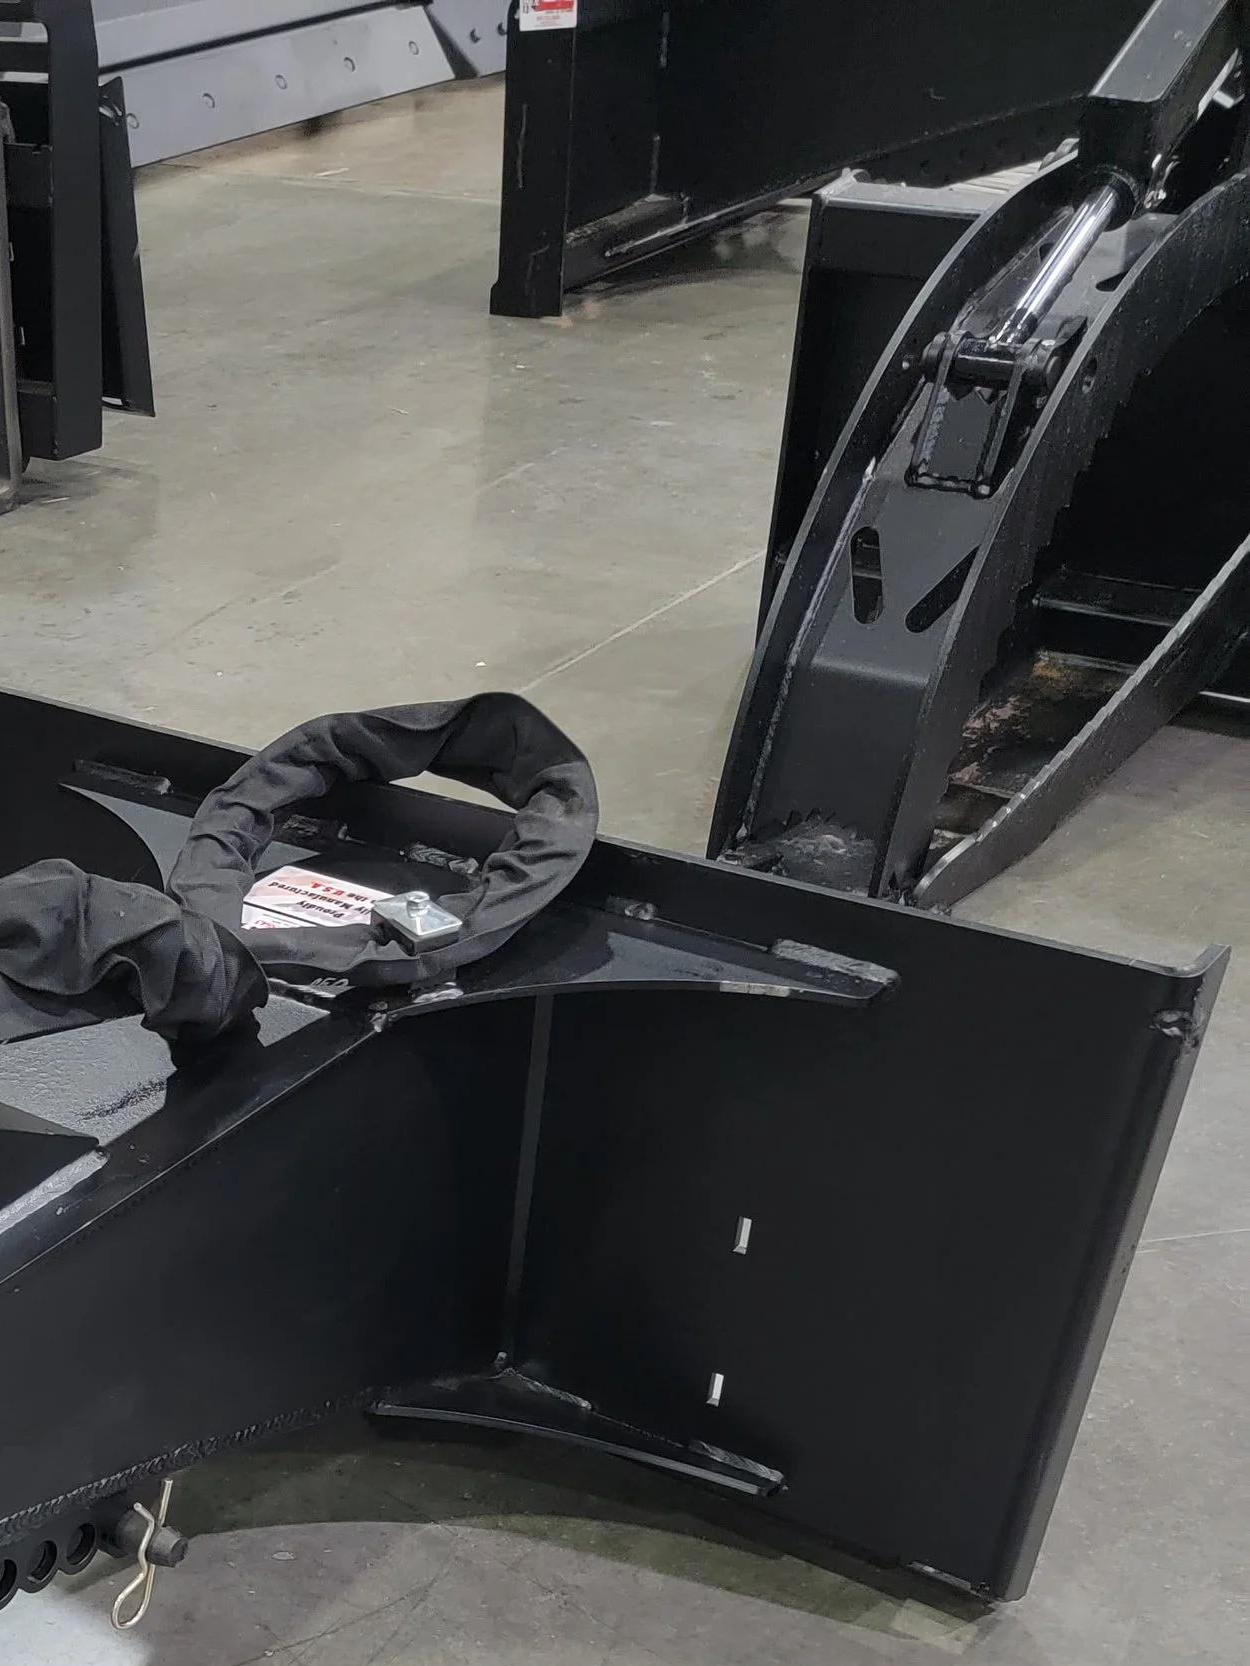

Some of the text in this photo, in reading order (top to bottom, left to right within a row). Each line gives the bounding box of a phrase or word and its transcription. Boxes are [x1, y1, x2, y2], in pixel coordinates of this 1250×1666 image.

[268, 881, 353, 910] Manufactured
[347, 891, 368, 902] the
[295, 900, 344, 919] Proudly
